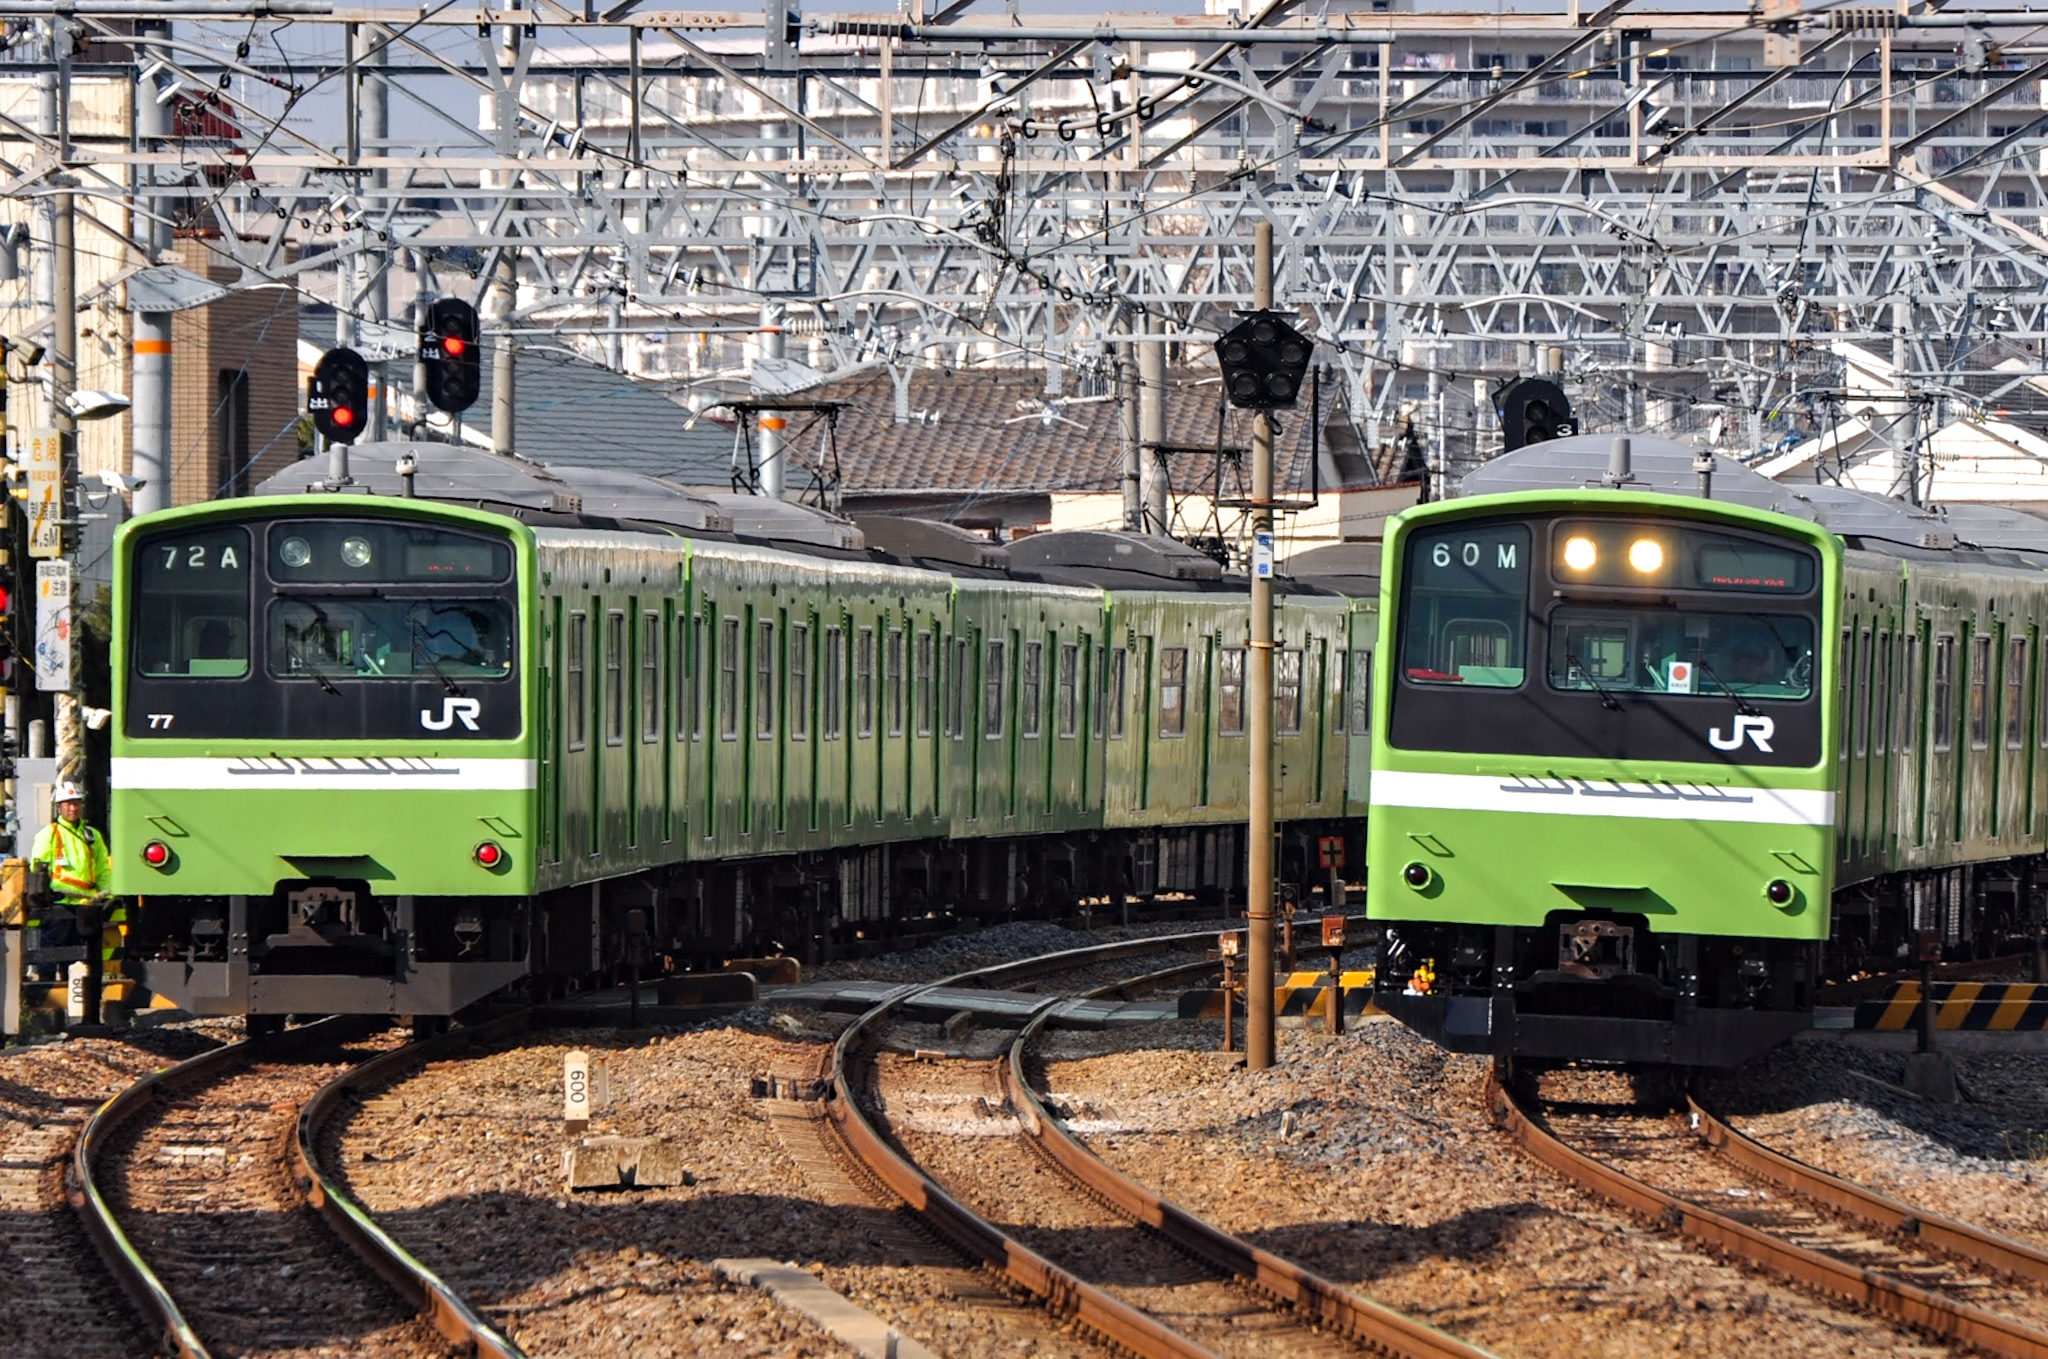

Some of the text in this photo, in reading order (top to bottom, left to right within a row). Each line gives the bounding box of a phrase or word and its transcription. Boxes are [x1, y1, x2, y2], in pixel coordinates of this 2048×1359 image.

[1556, 423, 1574, 437] 3
[147, 714, 174, 729] 77
[420, 697, 481, 731] JR
[1708, 714, 1775, 753] JR
[570, 1069, 586, 1103] 600
